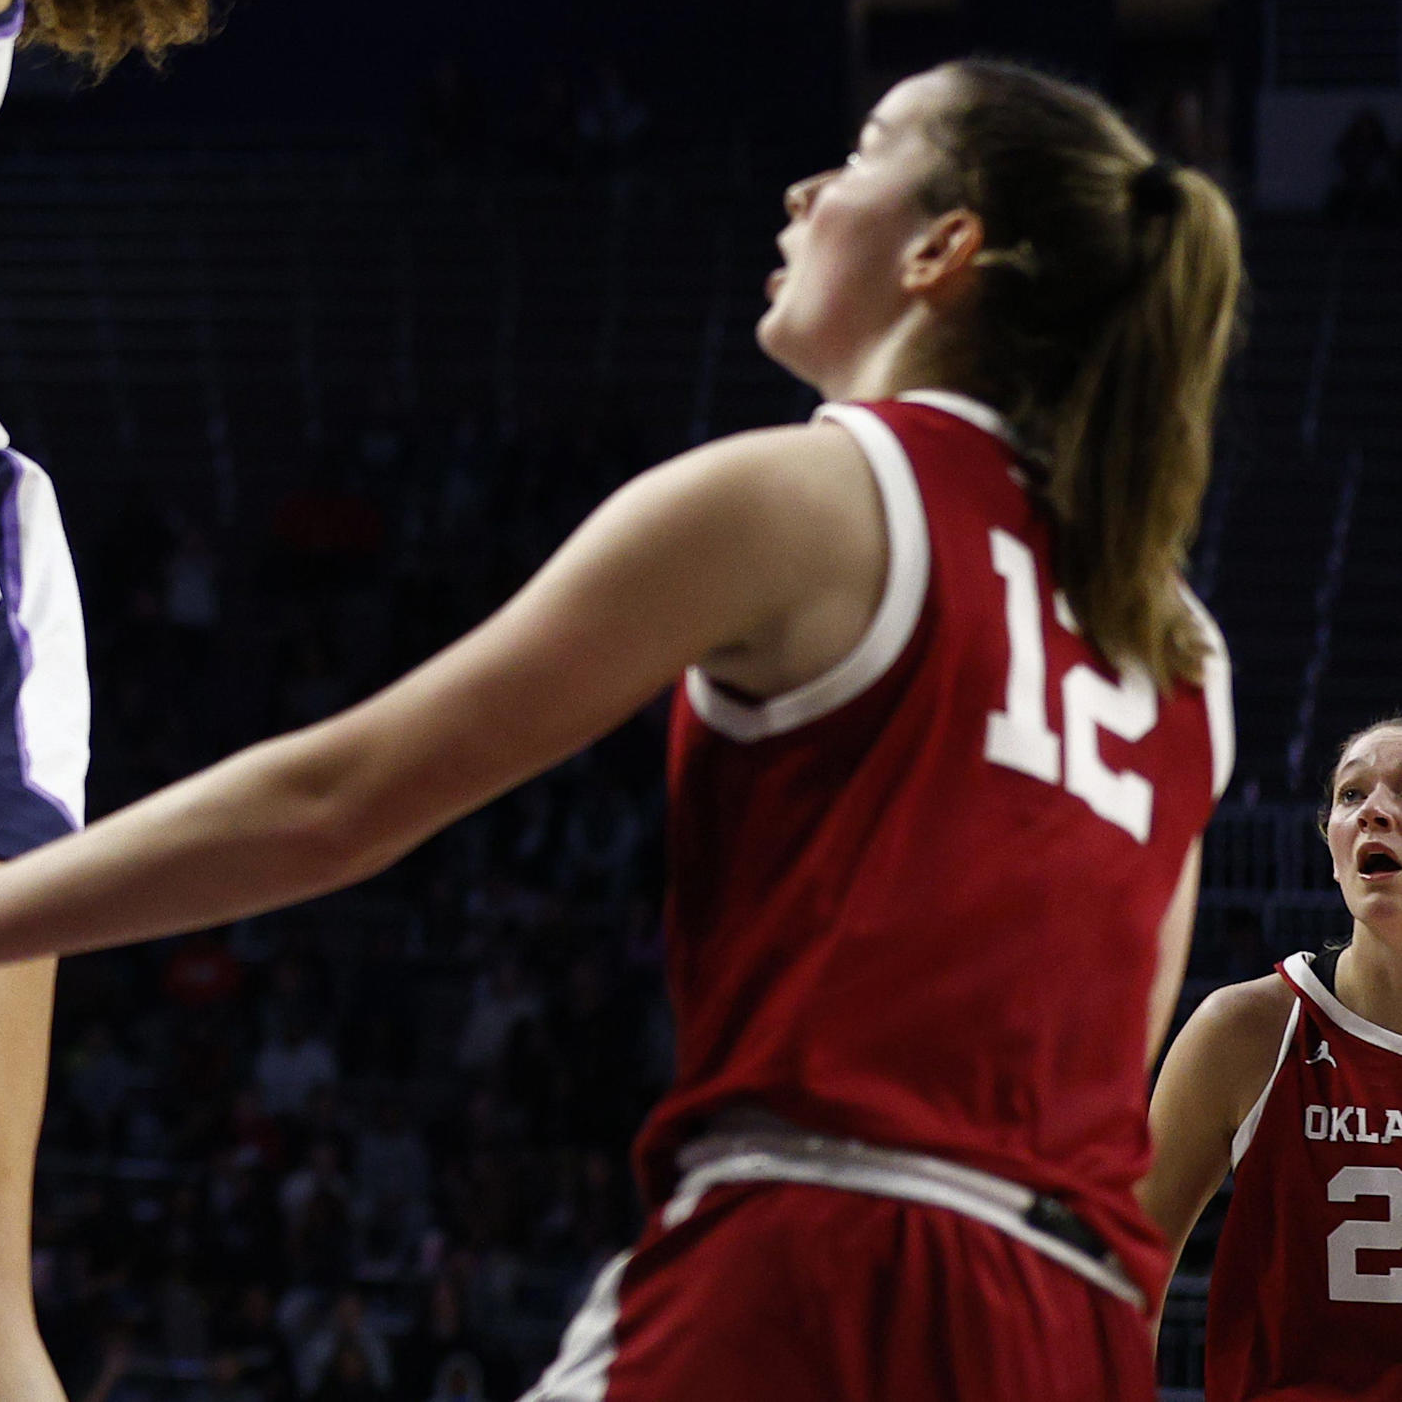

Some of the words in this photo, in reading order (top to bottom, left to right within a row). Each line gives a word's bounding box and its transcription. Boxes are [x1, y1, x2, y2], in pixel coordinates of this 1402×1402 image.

[982, 526, 1158, 846] 12
[1305, 1104, 1402, 1144] OKLA
[1327, 1165, 1402, 1303] 2
